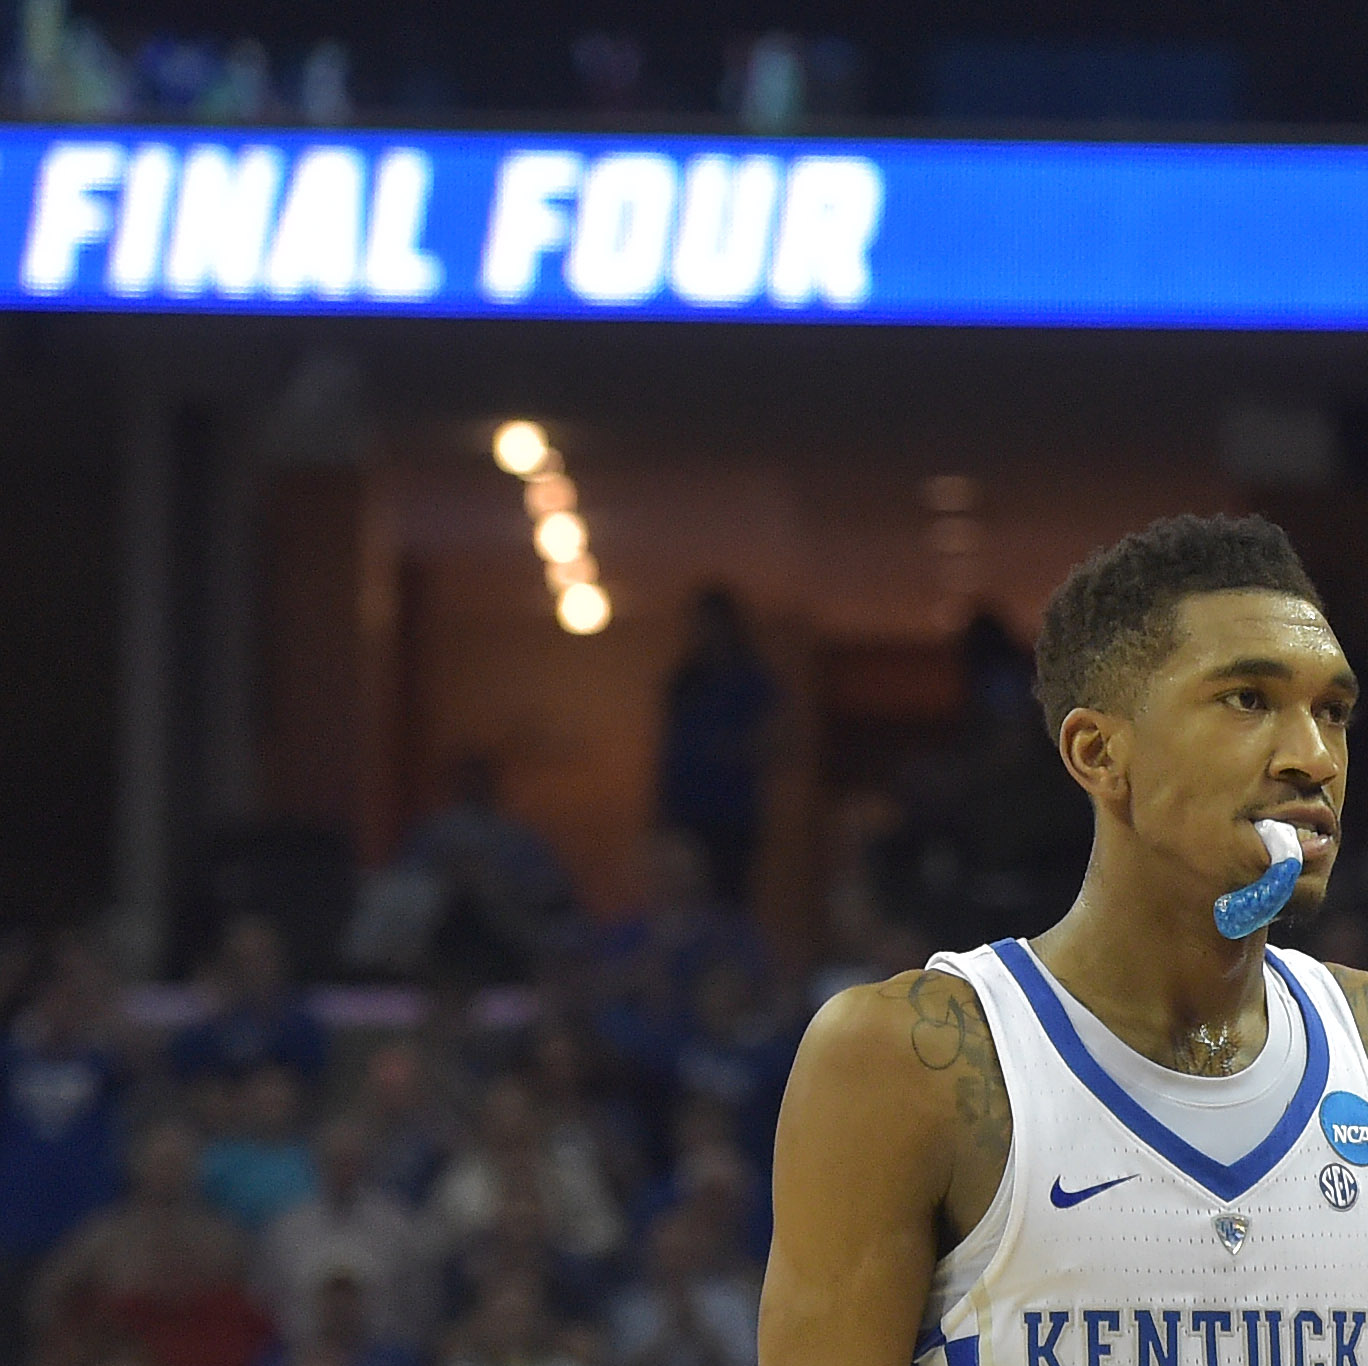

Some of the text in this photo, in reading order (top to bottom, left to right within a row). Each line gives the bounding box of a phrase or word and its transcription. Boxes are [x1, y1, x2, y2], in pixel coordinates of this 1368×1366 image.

[20, 141, 885, 310] FINAL FOUR
[1320, 1164, 1357, 1208] SEC
